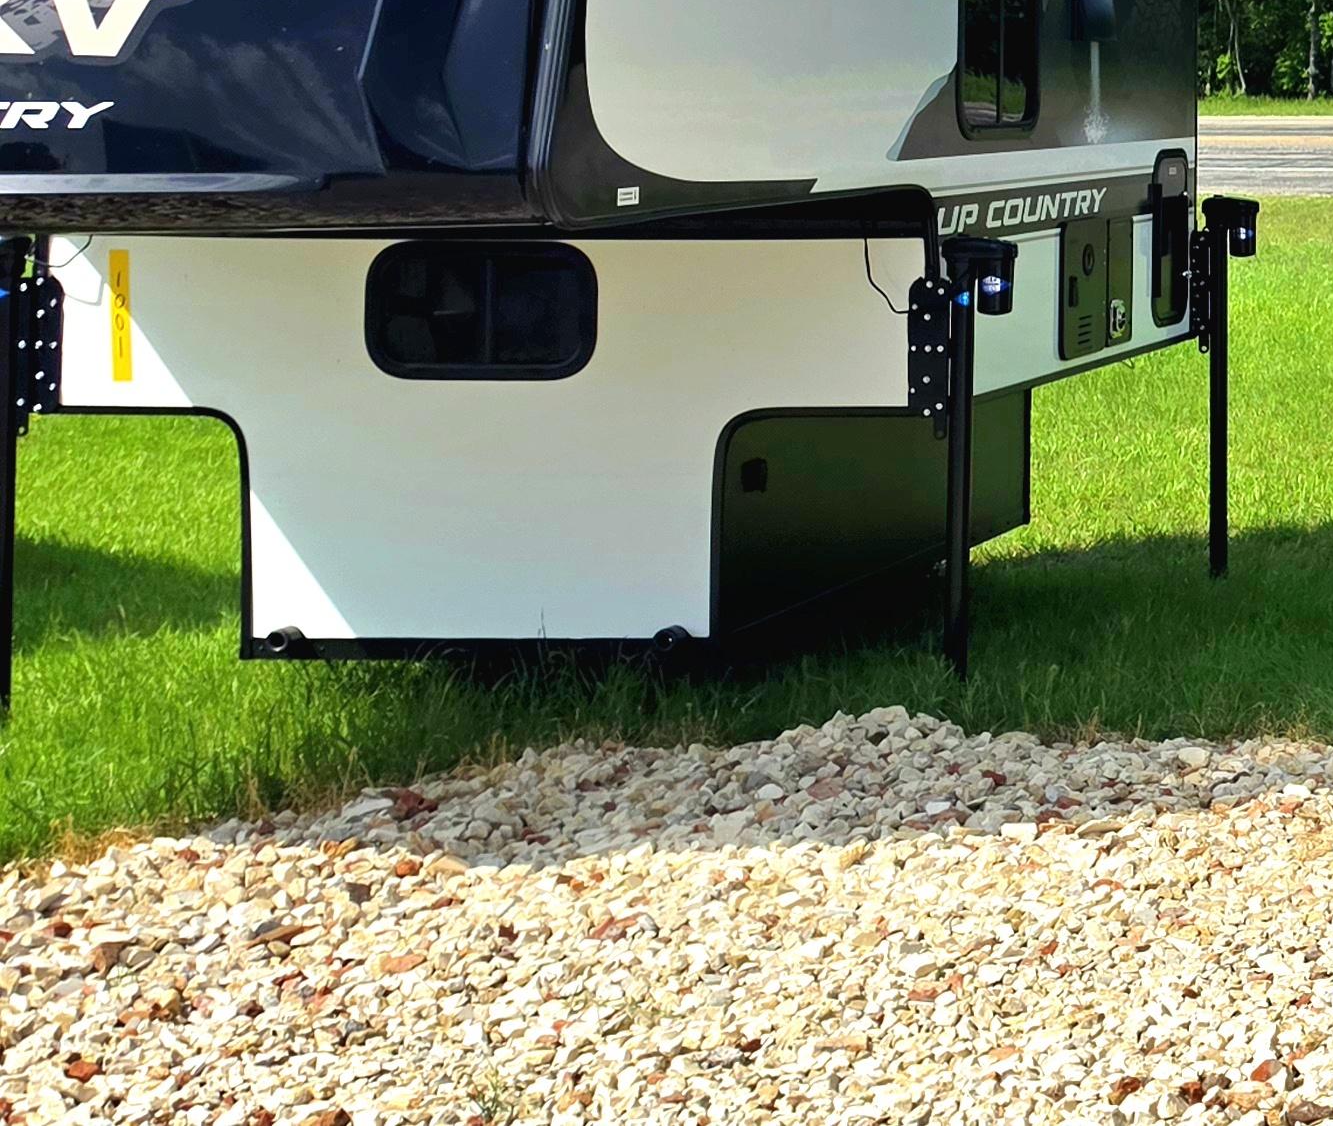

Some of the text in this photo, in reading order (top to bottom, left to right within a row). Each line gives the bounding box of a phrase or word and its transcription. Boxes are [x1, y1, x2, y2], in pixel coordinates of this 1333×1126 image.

[0, 101, 115, 129] RY
[937, 187, 1108, 236] UP COUNTRY
